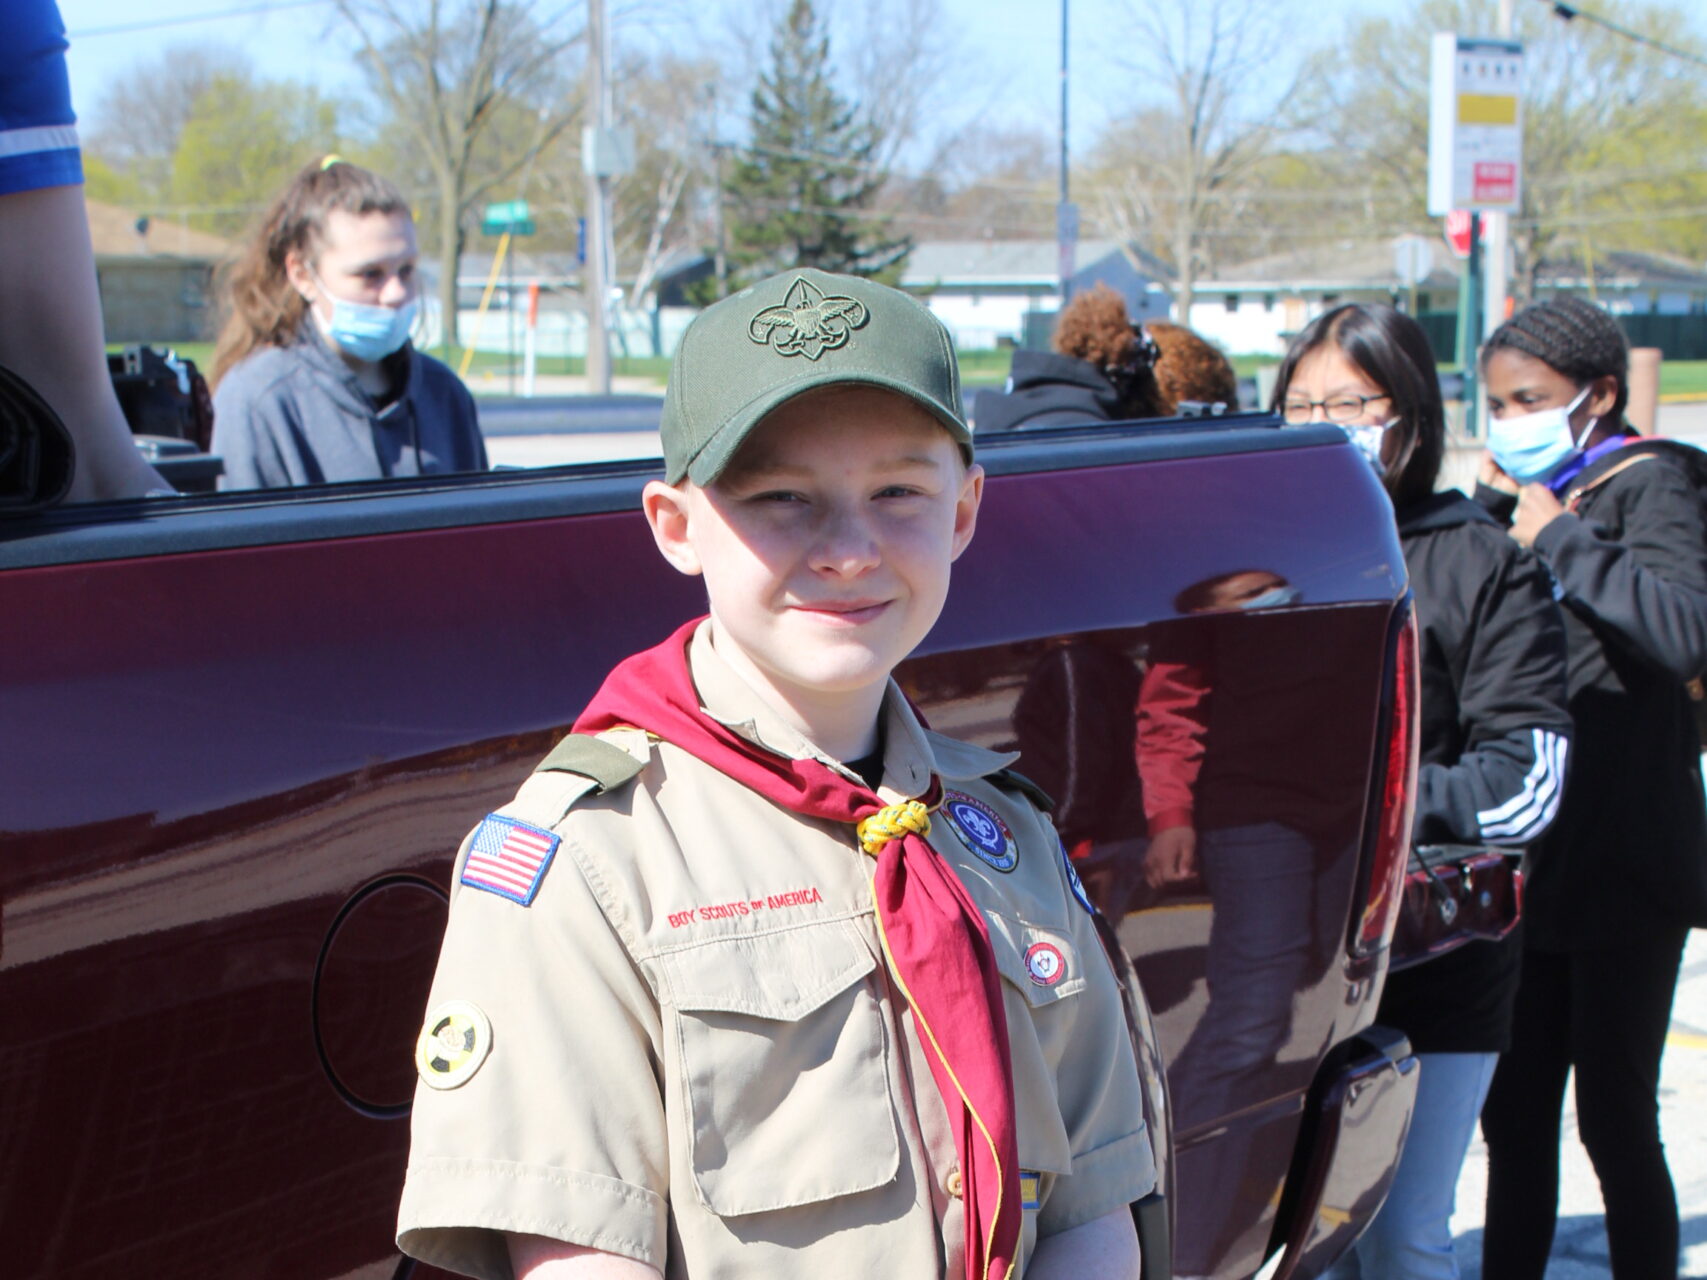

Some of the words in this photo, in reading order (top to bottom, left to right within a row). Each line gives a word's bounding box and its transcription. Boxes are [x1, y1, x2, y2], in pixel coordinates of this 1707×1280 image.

[667, 909, 697, 929] BOY
[699, 901, 750, 921] SCOUTS
[767, 887, 824, 910] AMERICA
